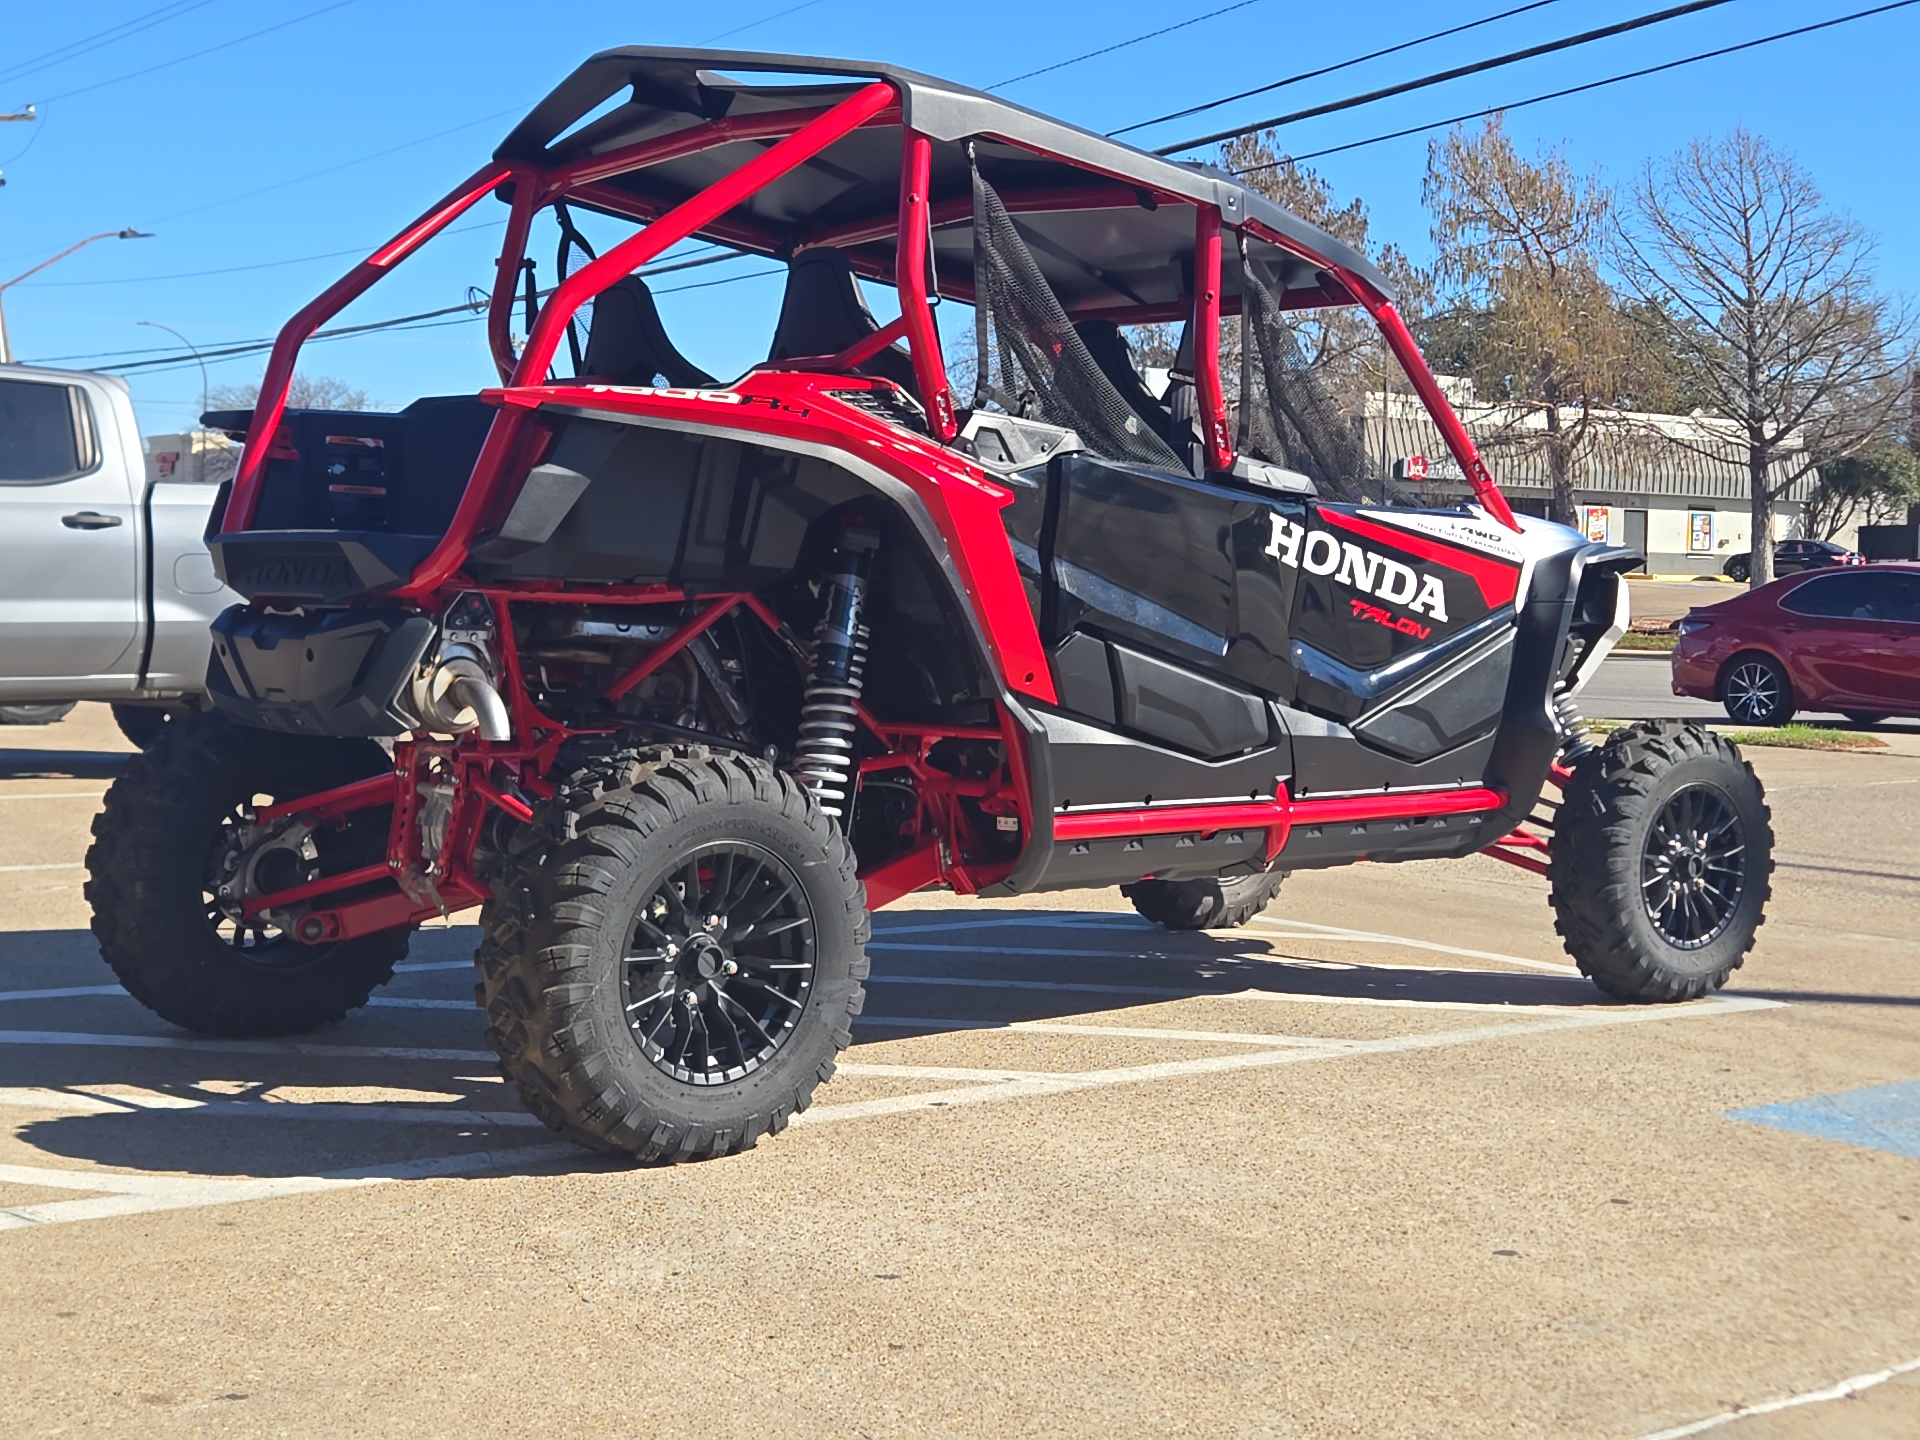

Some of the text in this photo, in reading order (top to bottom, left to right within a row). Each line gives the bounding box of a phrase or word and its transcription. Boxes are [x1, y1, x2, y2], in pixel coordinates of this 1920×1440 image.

[1264, 512, 1449, 623] HONDA
[1466, 536, 1516, 557] Transmission
[1349, 598, 1431, 640] TALON
